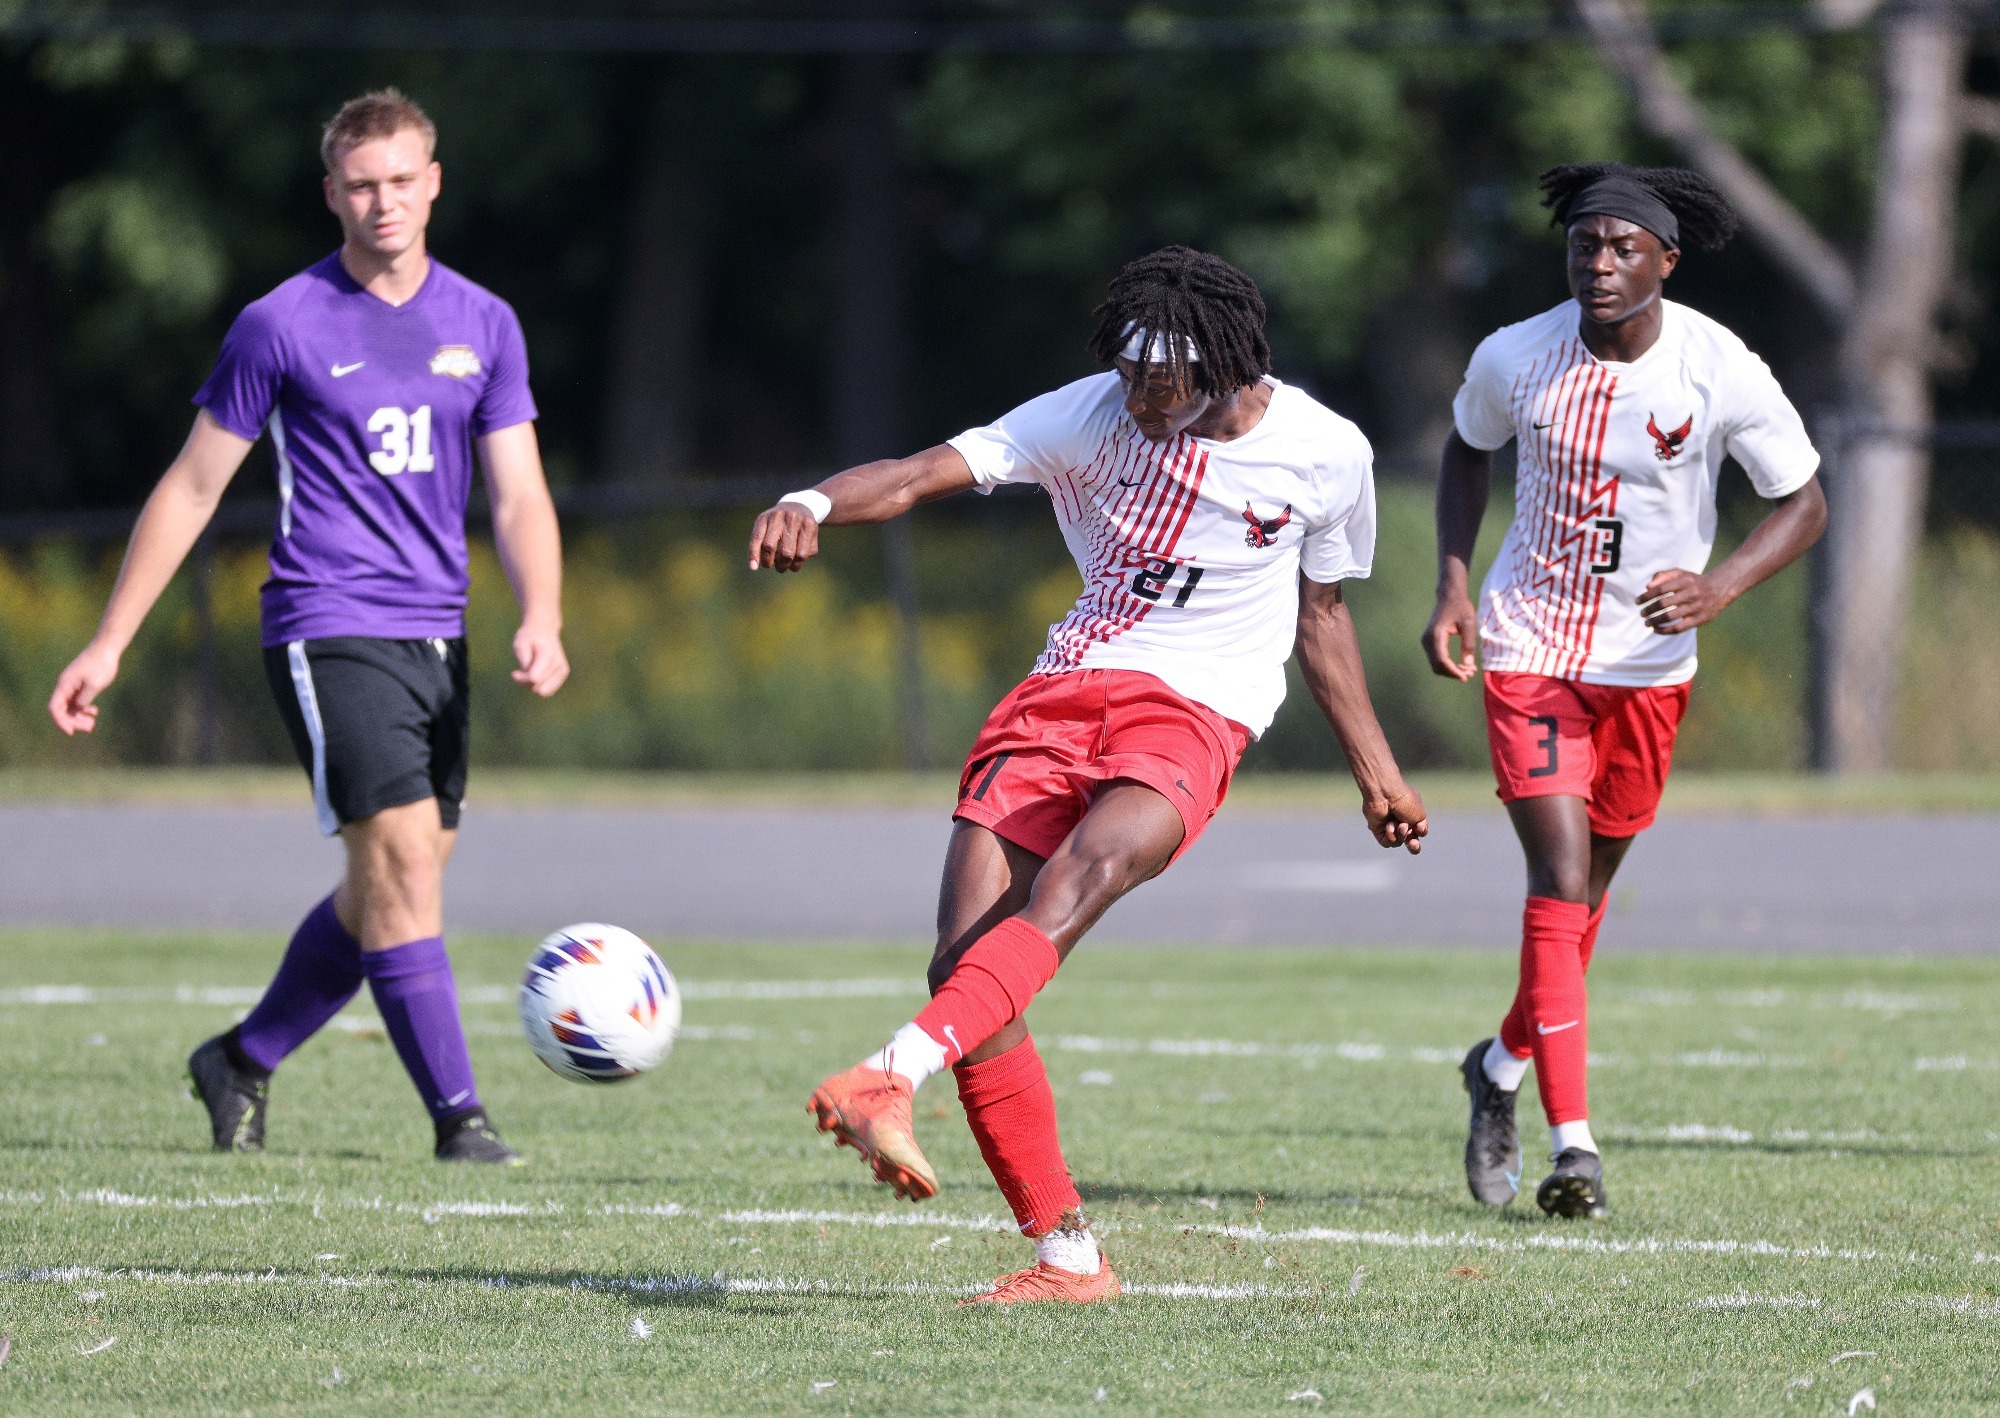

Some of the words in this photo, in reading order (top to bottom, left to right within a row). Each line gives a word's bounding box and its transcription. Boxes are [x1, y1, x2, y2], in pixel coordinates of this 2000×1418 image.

[367, 405, 434, 475] 31
[1591, 520, 1623, 574] 3
[1131, 562, 1204, 608] 21
[1528, 715, 1558, 778] 3
